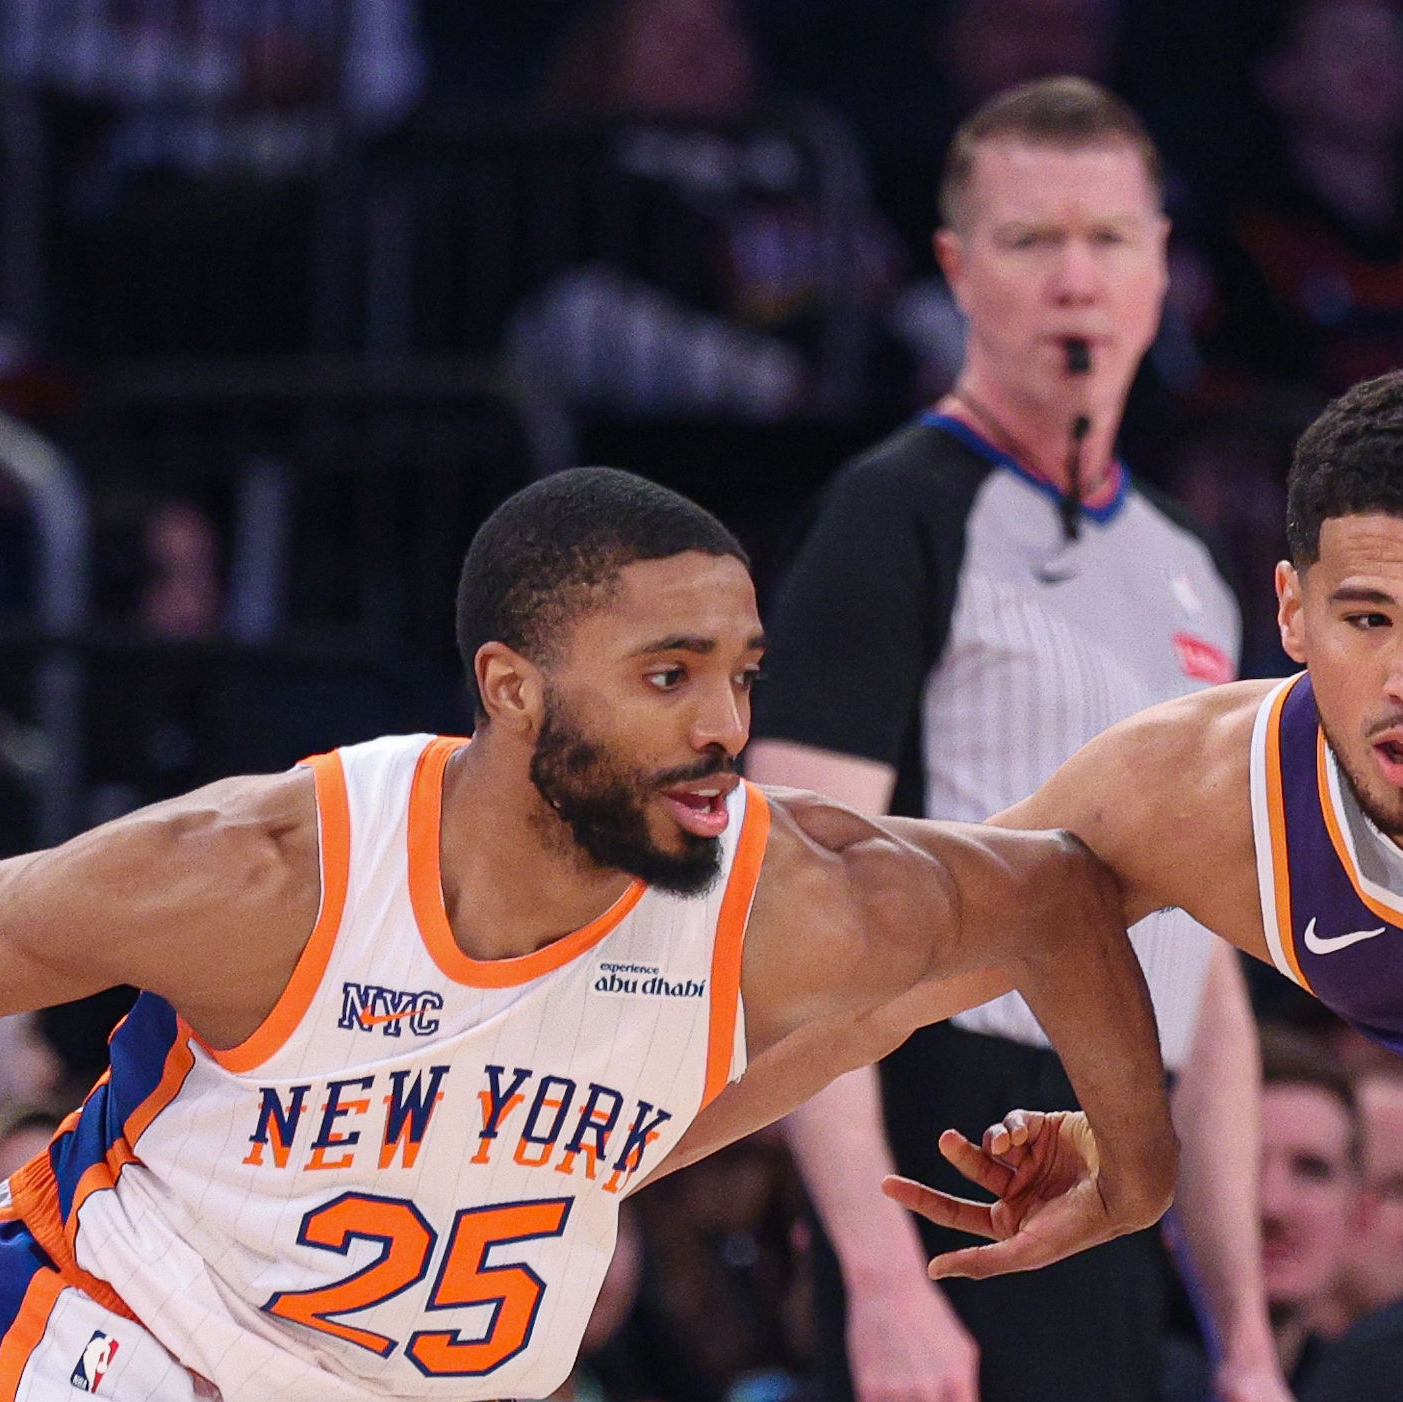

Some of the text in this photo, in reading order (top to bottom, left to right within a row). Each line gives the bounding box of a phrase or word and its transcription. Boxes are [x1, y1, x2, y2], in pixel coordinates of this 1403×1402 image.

[594, 974, 706, 997] abu dhabi
[600, 962, 660, 975] experience
[337, 981, 445, 1038] NYC
[243, 1065, 673, 1194] NEW YORK
[260, 1191, 575, 1377] 25
